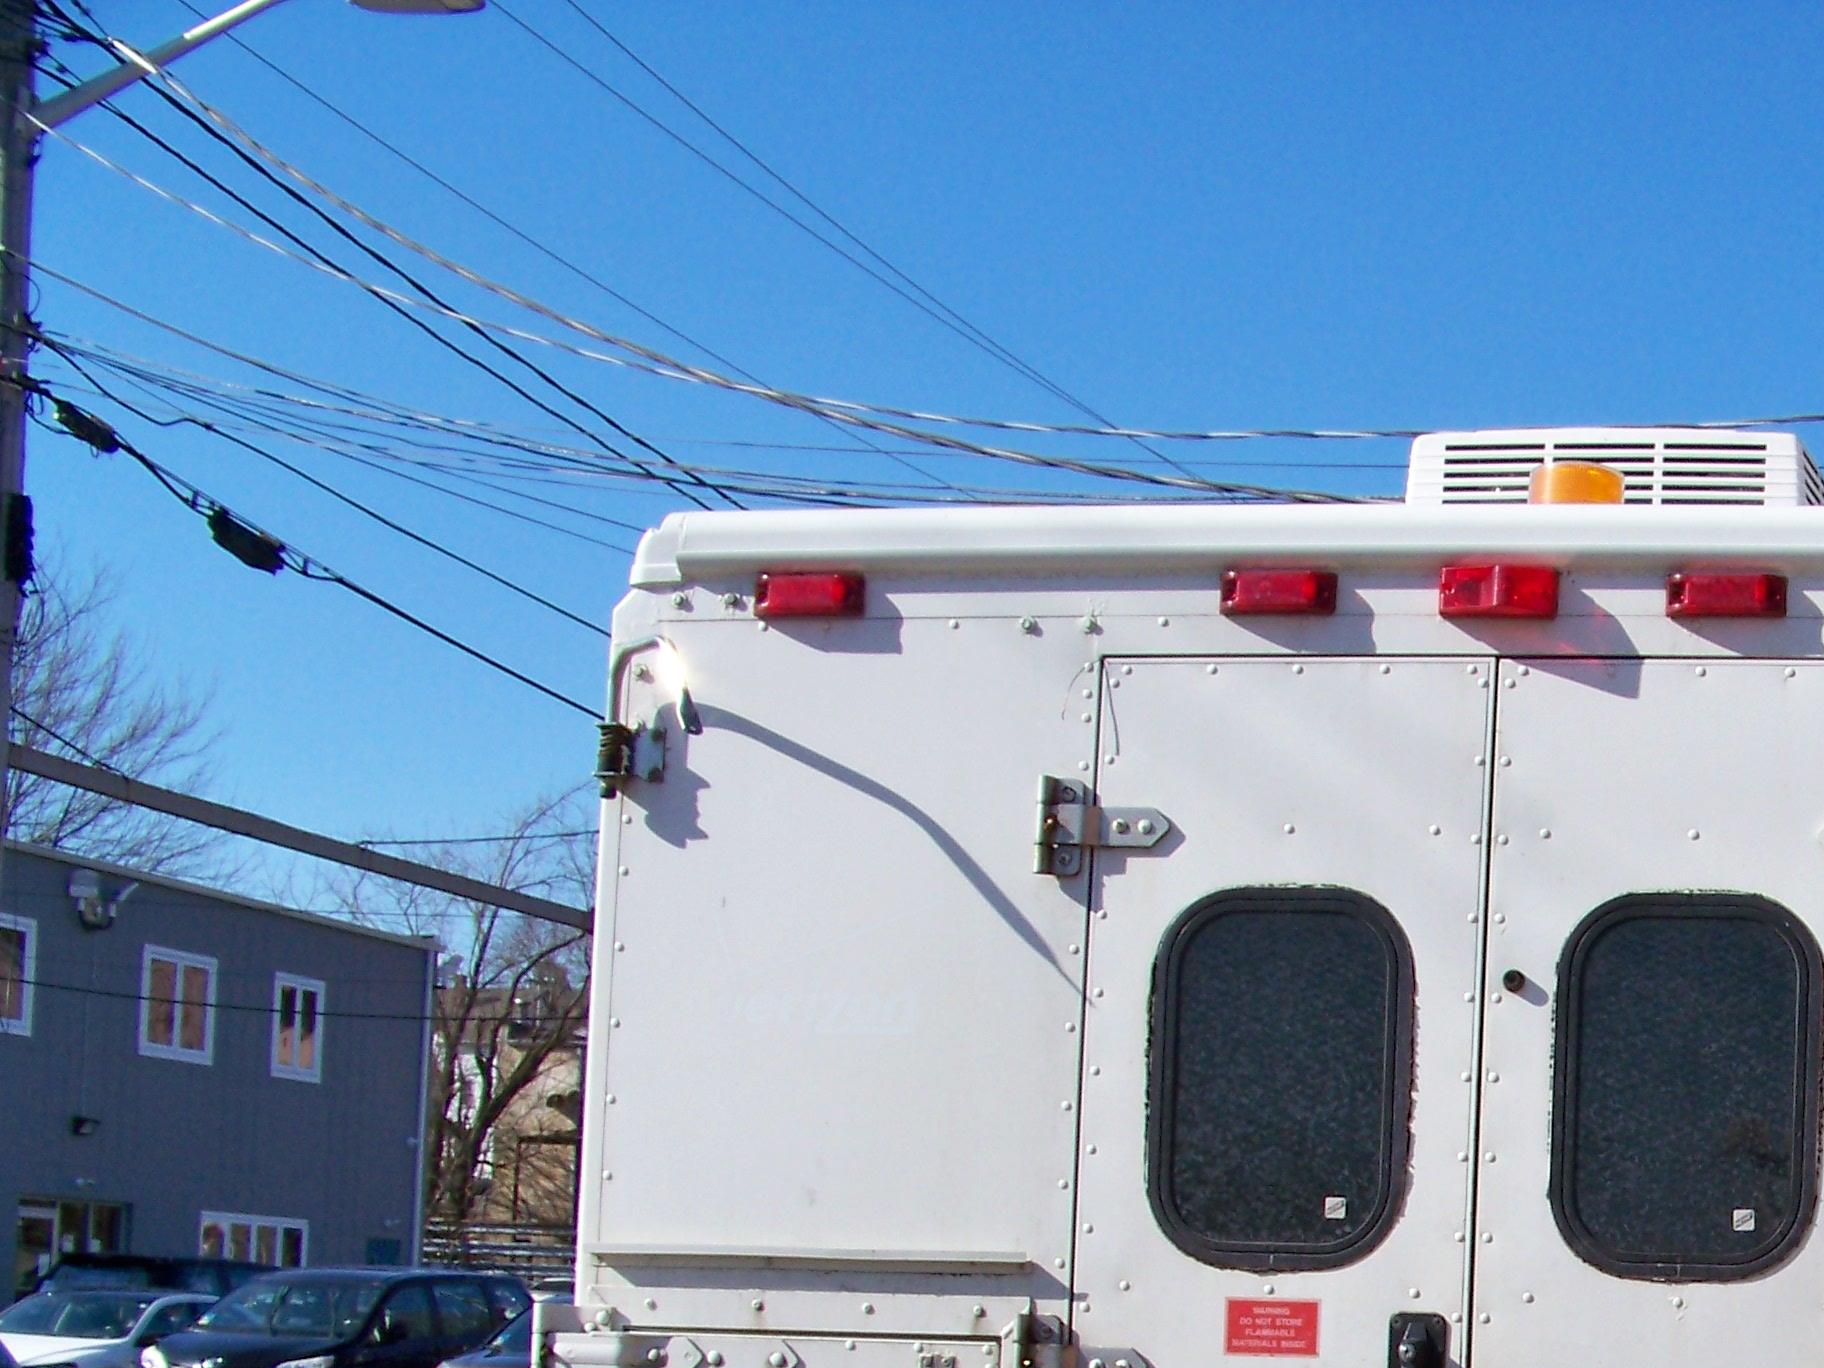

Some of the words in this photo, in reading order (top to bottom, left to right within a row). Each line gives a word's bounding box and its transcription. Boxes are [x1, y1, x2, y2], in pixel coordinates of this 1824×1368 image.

[1252, 1306, 1290, 1315] WARNING
[1239, 1316, 1253, 1325] DO
[1255, 1317, 1272, 1326] NOT
[1275, 1318, 1303, 1327] STORE
